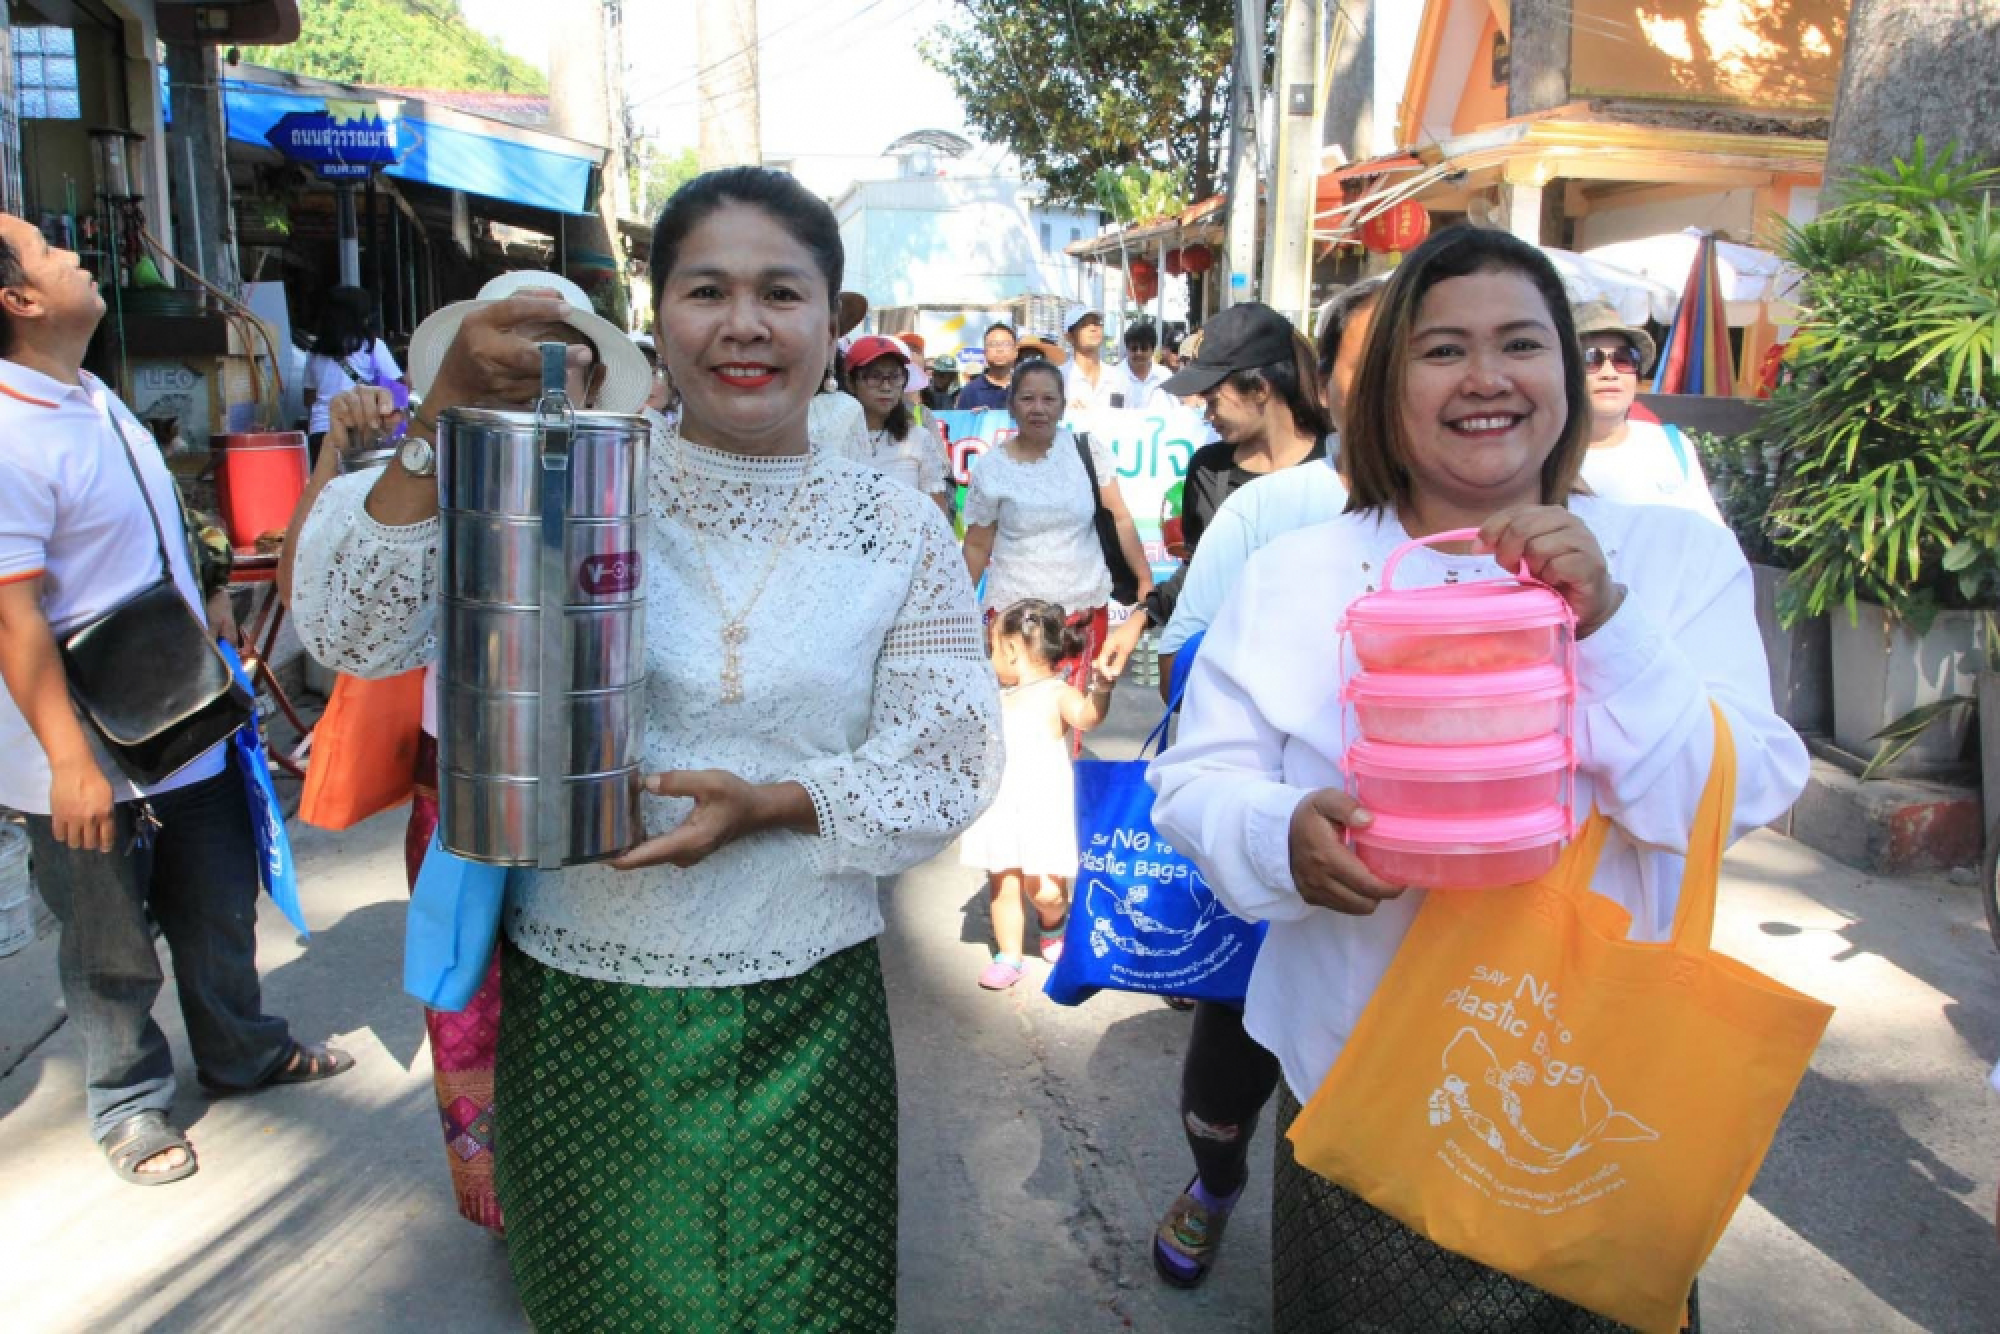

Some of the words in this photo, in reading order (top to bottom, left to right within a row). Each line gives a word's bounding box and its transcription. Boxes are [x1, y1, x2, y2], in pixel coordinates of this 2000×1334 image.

[145, 369, 193, 391] LEO
[1134, 860, 1188, 884] Bags
[1470, 966, 1512, 986] SAY
[1532, 1030, 1585, 1086] Bgs
